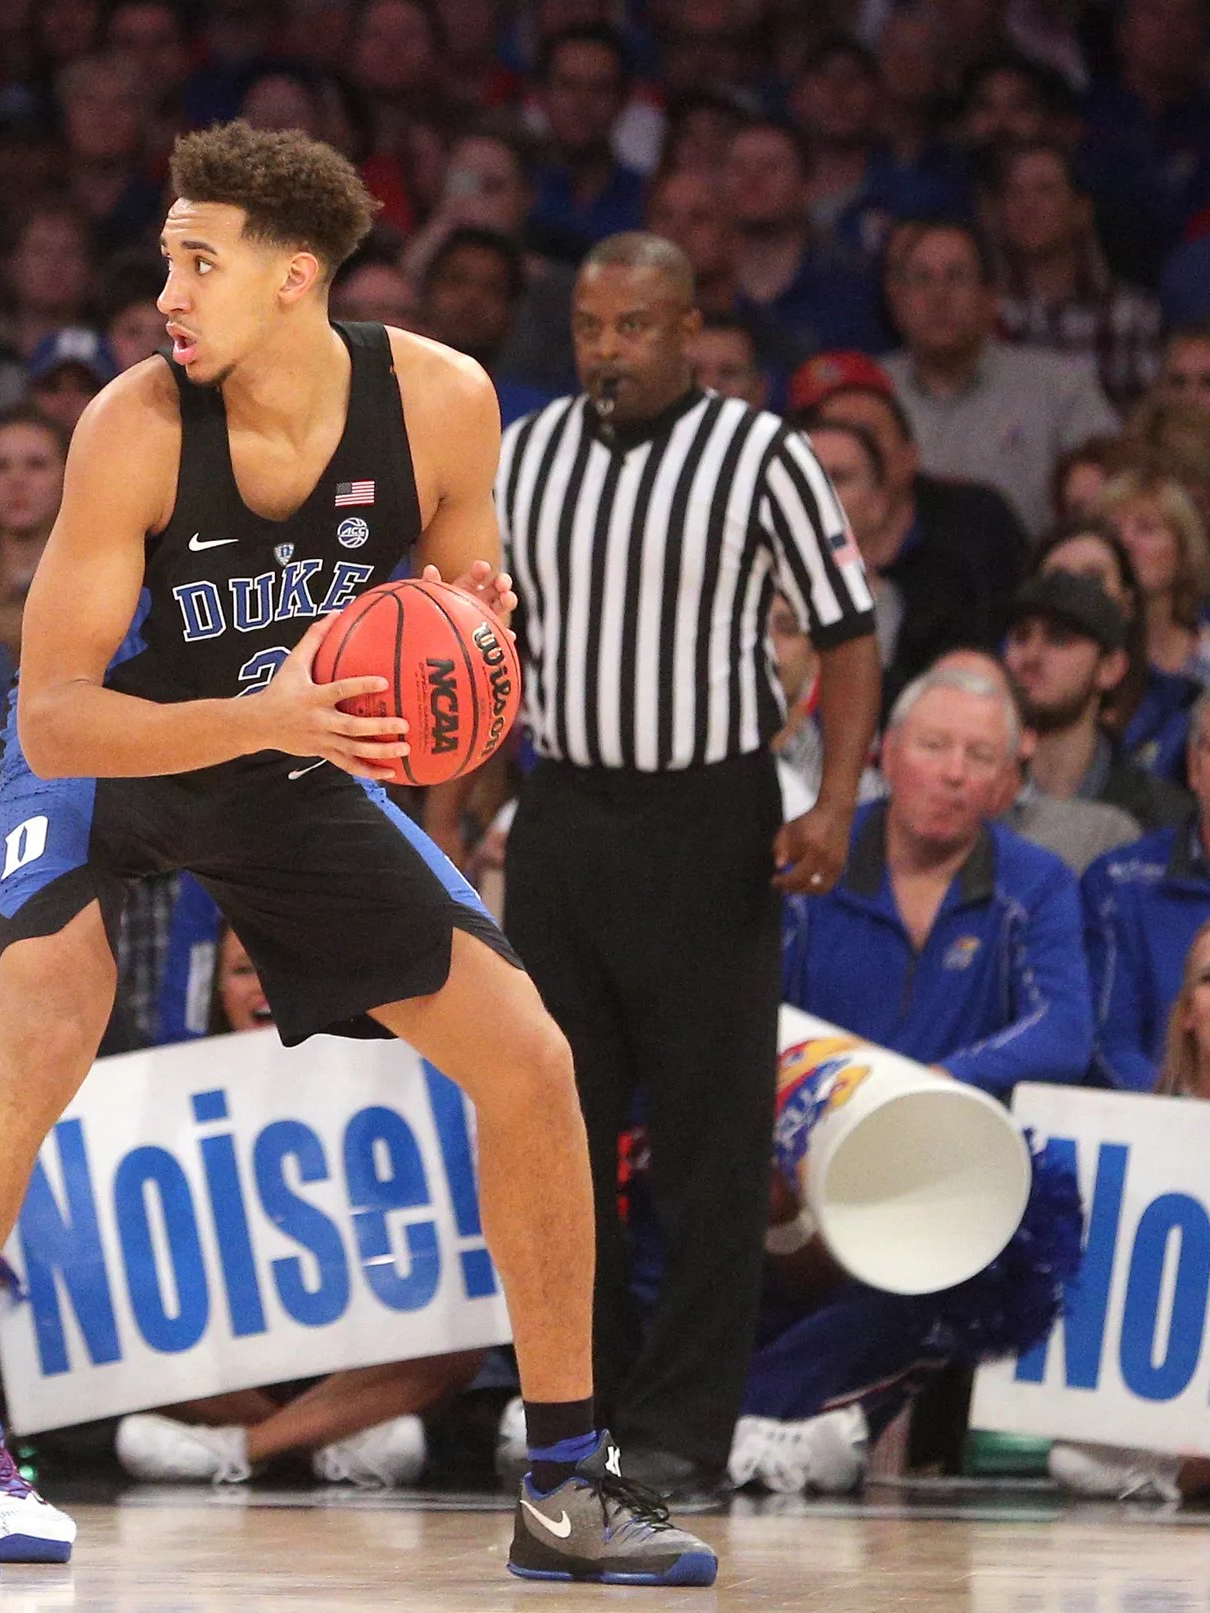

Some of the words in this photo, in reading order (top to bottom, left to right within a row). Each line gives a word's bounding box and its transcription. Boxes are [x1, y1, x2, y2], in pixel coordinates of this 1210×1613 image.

[172, 558, 375, 642] DUKE
[425, 658, 460, 755] NCAA
[472, 621, 511, 757] Wilson
[1, 815, 49, 880] D
[18, 1057, 497, 1378] Noise!
